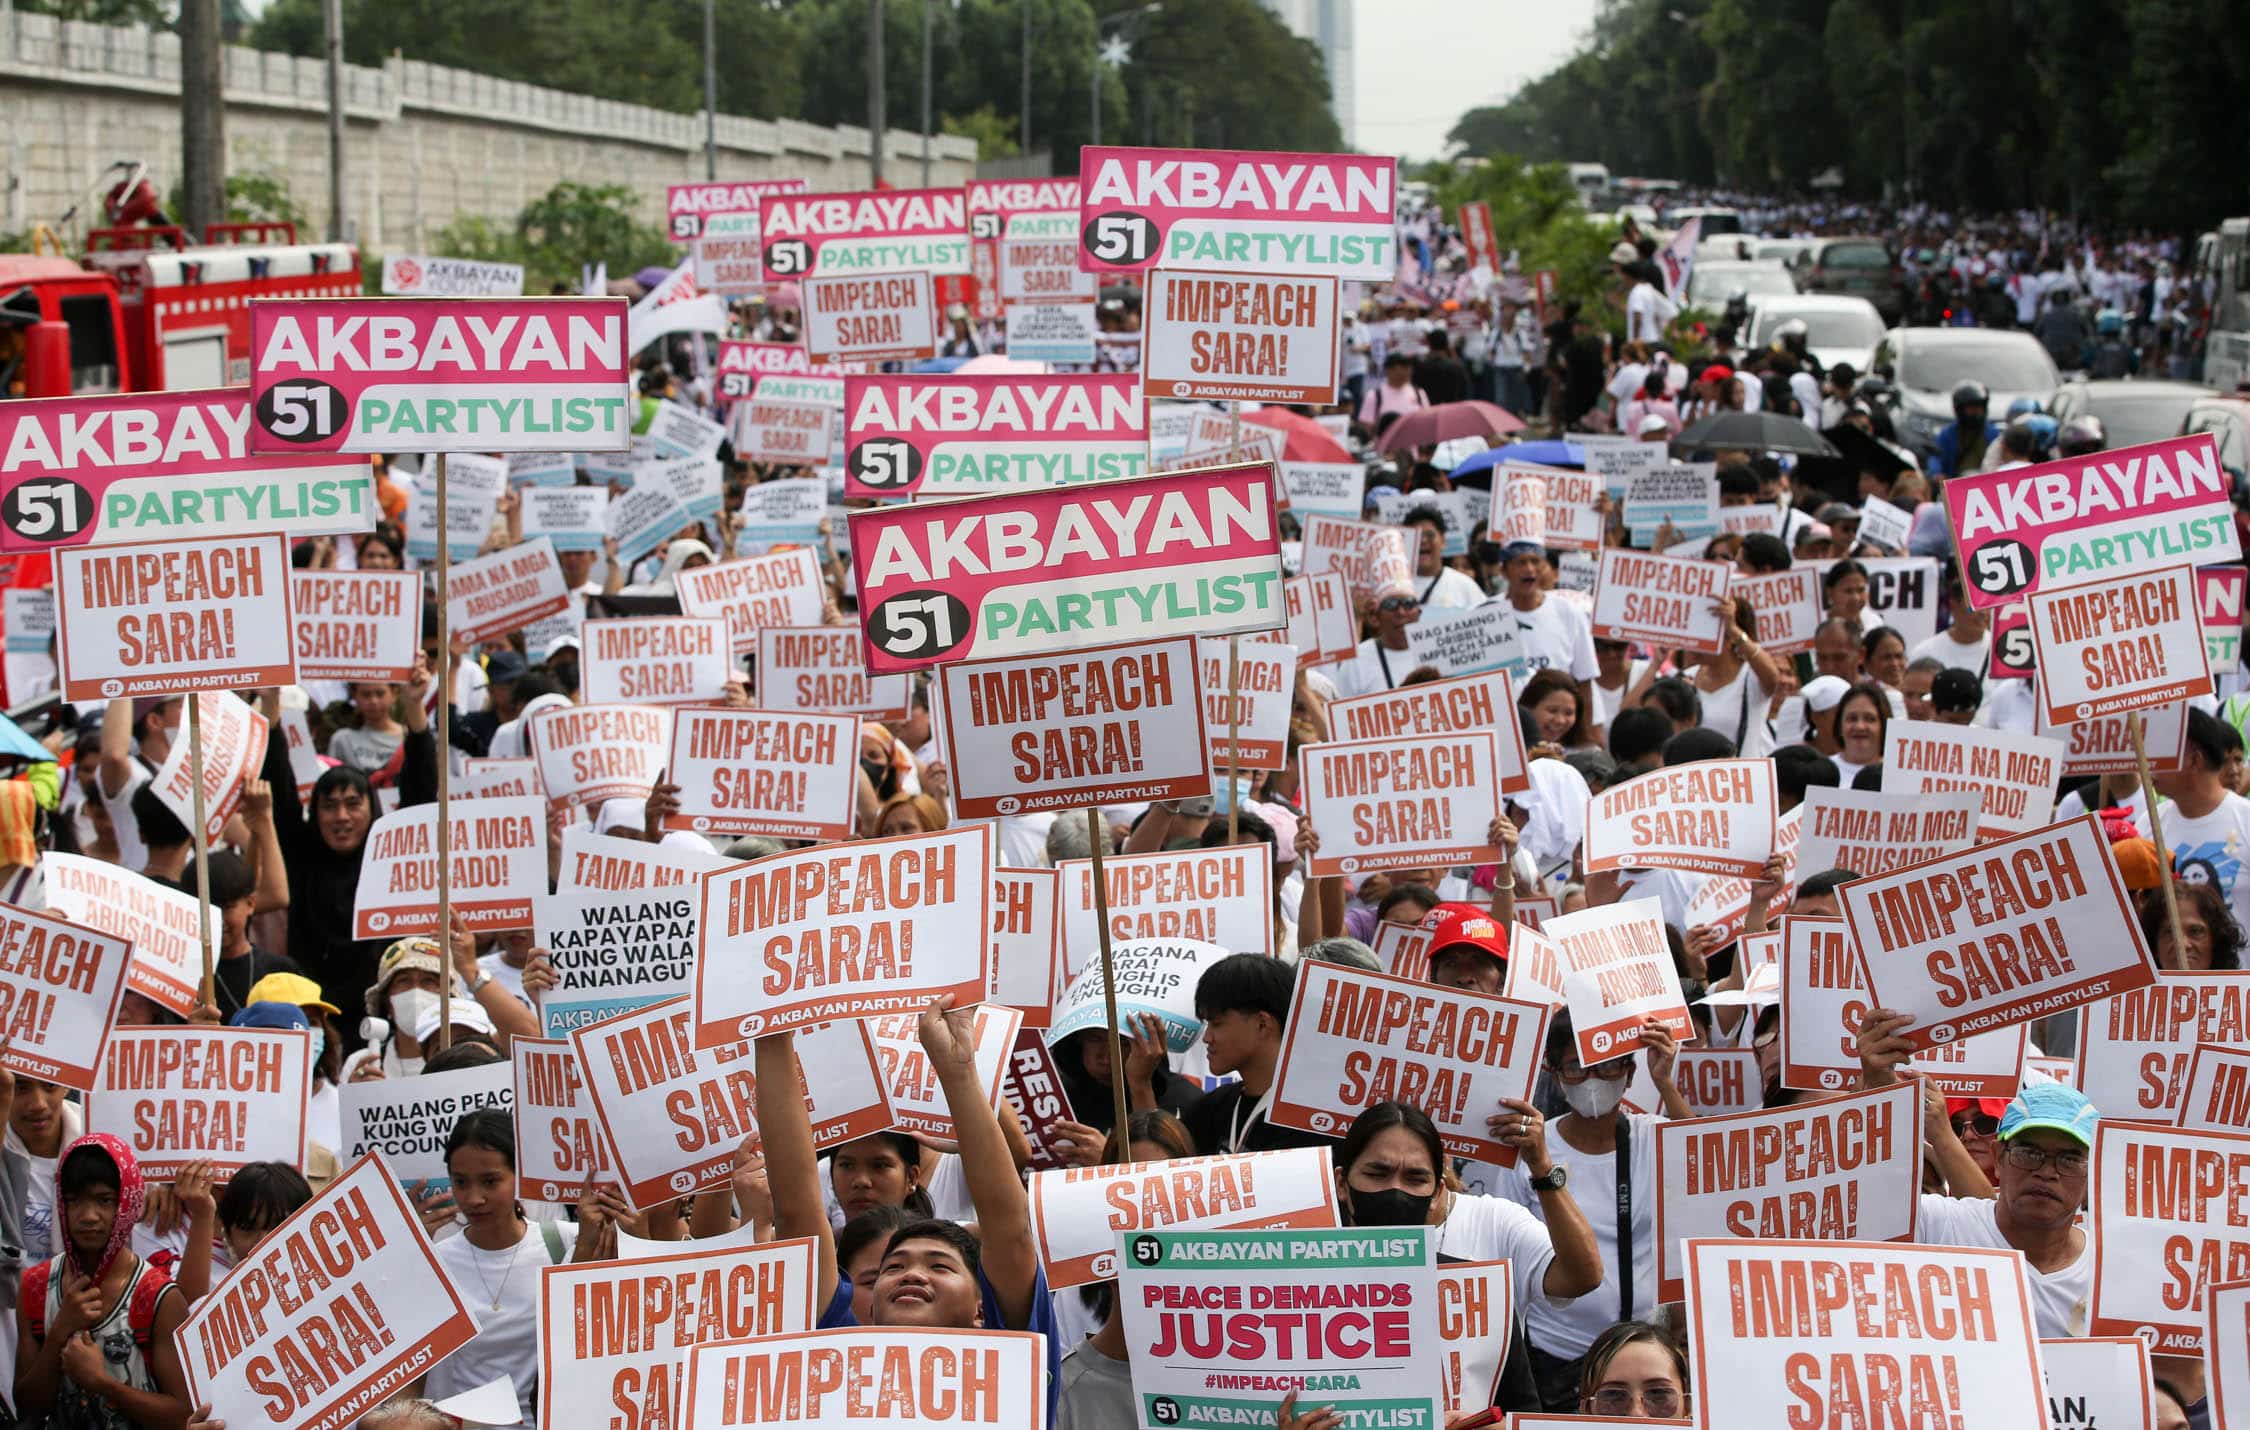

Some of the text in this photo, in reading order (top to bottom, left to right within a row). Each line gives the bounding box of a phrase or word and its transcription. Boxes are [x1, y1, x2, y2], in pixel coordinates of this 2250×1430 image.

[1086, 159, 1390, 212] AKBAYAN
[673, 215, 700, 237] 51
[763, 194, 964, 236] AKBAYAN
[973, 214, 1000, 238] 51
[771, 242, 967, 273] 51 PARTYLIST
[1094, 218, 1389, 264] 51 PARTYLIST
[427, 259, 517, 284] AKBAYAN
[816, 279, 916, 312] IMPEACH
[1166, 279, 1316, 327] IMPEACH
[258, 315, 622, 372] AKBAYAN
[837, 315, 901, 345] SARA!
[1190, 330, 1288, 376] SARA!
[722, 374, 750, 396] 51
[1195, 385, 1304, 399] AKBAYAN PARTYLIST
[270, 385, 331, 436] 51
[361, 397, 624, 434] PARTYLIST
[751, 405, 823, 428] IMPEACH
[850, 385, 1144, 432] AKBAYAN
[1, 404, 252, 473] AKBAY
[762, 431, 809, 450] SARA!
[859, 442, 908, 484] 51
[932, 452, 1146, 482] PARTYLIST
[17, 483, 77, 536] 51
[107, 479, 369, 529] PARTYLIST
[1962, 444, 2221, 540] AKBAYAN
[865, 482, 1271, 588] AKBAYAN
[1976, 514, 2230, 592] 51 PARTYLIST
[81, 546, 263, 609] IMPEACH
[488, 551, 550, 584] NA MGA
[693, 558, 804, 603] IMPEACH
[1612, 557, 1714, 597] IMPEACH
[466, 577, 541, 618] ABUSADO!
[721, 597, 793, 635] SARA!
[884, 594, 953, 653] 51
[984, 571, 1278, 641] PARTYLIST
[1624, 593, 1691, 629] SARA!
[2048, 577, 2180, 644] IMPEACH
[118, 608, 235, 666] SARA!
[297, 622, 377, 659] SARA!
[597, 626, 713, 661] IMPEACH
[1411, 614, 1494, 643] WAG KAMING
[1419, 632, 1513, 664] IMPEACH SARA
[1437, 629, 1485, 647] DRIBBLE
[1450, 650, 1487, 667] NOW!
[2082, 633, 2167, 691] SARA!
[128, 677, 190, 692] AKBAYAN
[193, 672, 260, 687] PARTYLIST
[620, 662, 693, 699] SARA!
[796, 673, 872, 707] SARA!
[969, 652, 1173, 727] IMPEACH
[2096, 686, 2187, 713] AKBAYAN PARTYLIST
[547, 711, 661, 752] IMPEACH
[1348, 683, 1495, 738] IMPEACH
[690, 717, 835, 765] IMPEACH
[1012, 719, 1143, 784] SARA!
[572, 747, 646, 783] SARA!
[1323, 744, 1476, 798] IMPEACH
[1897, 738, 2051, 788] TAMA NA MGA
[711, 766, 808, 813] SARA!
[1001, 784, 1171, 811] 51 AKBAYAN PARTYLIST
[1605, 767, 1754, 819] IMPEACH
[372, 815, 536, 860] TAMA MGA
[713, 820, 823, 836] AKBAYAN PARTYLIST
[1353, 797, 1453, 847] SARA!
[1631, 808, 1730, 849] SARA!
[1814, 805, 1969, 843] TAMA NA MGA
[575, 851, 646, 891] TAMA
[1362, 851, 1473, 869] AKBAYAN PARTYLIST
[1640, 856, 1746, 875] AKBAYAN PARTYLIST
[56, 865, 158, 921] TAMA NA
[728, 844, 956, 938] IMPEACH
[1082, 856, 1245, 911] IMPEACH
[1868, 837, 2088, 952] IMPEACH
[85, 900, 189, 968] ABUSADO!
[464, 907, 530, 921] PARTYLIST
[582, 900, 691, 926] WALANG
[548, 948, 618, 970] KUNG
[763, 919, 913, 997] SARA!
[1560, 929, 1611, 973] TAMA
[1926, 917, 2076, 1009] SARA!
[138, 969, 193, 1006] PARTYLIST
[1161, 973, 1181, 987] IS
[1597, 961, 1667, 1008] ABUSADO!
[742, 994, 942, 1034] 51 AKBAYAN PARTYLIST
[1317, 978, 1520, 1069] IMPEACH
[1934, 979, 2112, 1041] 51 AKBAYAN PARTYLIST
[1596, 1035, 1607, 1048] 51
[2, 1053, 61, 1078] ARTYLIST
[106, 1039, 283, 1094] IMPEACH
[1824, 1073, 1838, 1085] 51
[359, 1088, 513, 1123] WALANG PEAC
[1339, 1050, 1473, 1126] SARA!
[134, 1098, 248, 1153] SARA!
[363, 1120, 427, 1140] KUNG
[1314, 1115, 1331, 1128] 51
[1685, 1100, 1893, 1195] IMPEACH
[676, 1175, 692, 1188] 51
[1106, 1161, 1256, 1231] SARA!
[2125, 1142, 2250, 1228] IMPE
[1726, 1179, 1857, 1240] SARA!
[1097, 1258, 1113, 1272] 51
[1137, 1238, 1420, 1260] 51 AKBAYAN PARTYLIST
[199, 1186, 387, 1380] IMPEACH
[1144, 1283, 1412, 1309] PEACE DEMANDS
[1727, 1257, 1997, 1342] IMPEACH
[575, 1260, 785, 1360] IMPEACH
[245, 1282, 396, 1423] SARA!
[1149, 1310, 1412, 1361] JUSTICE
[359, 1343, 434, 1408] PARTYLIST
[722, 1344, 999, 1426] IMPEACH
[1205, 1375, 1361, 1392] #IMPEACHSARA
[1785, 1352, 1964, 1430] SARA!
[1156, 1402, 1281, 1425] 51 AKBAYA
